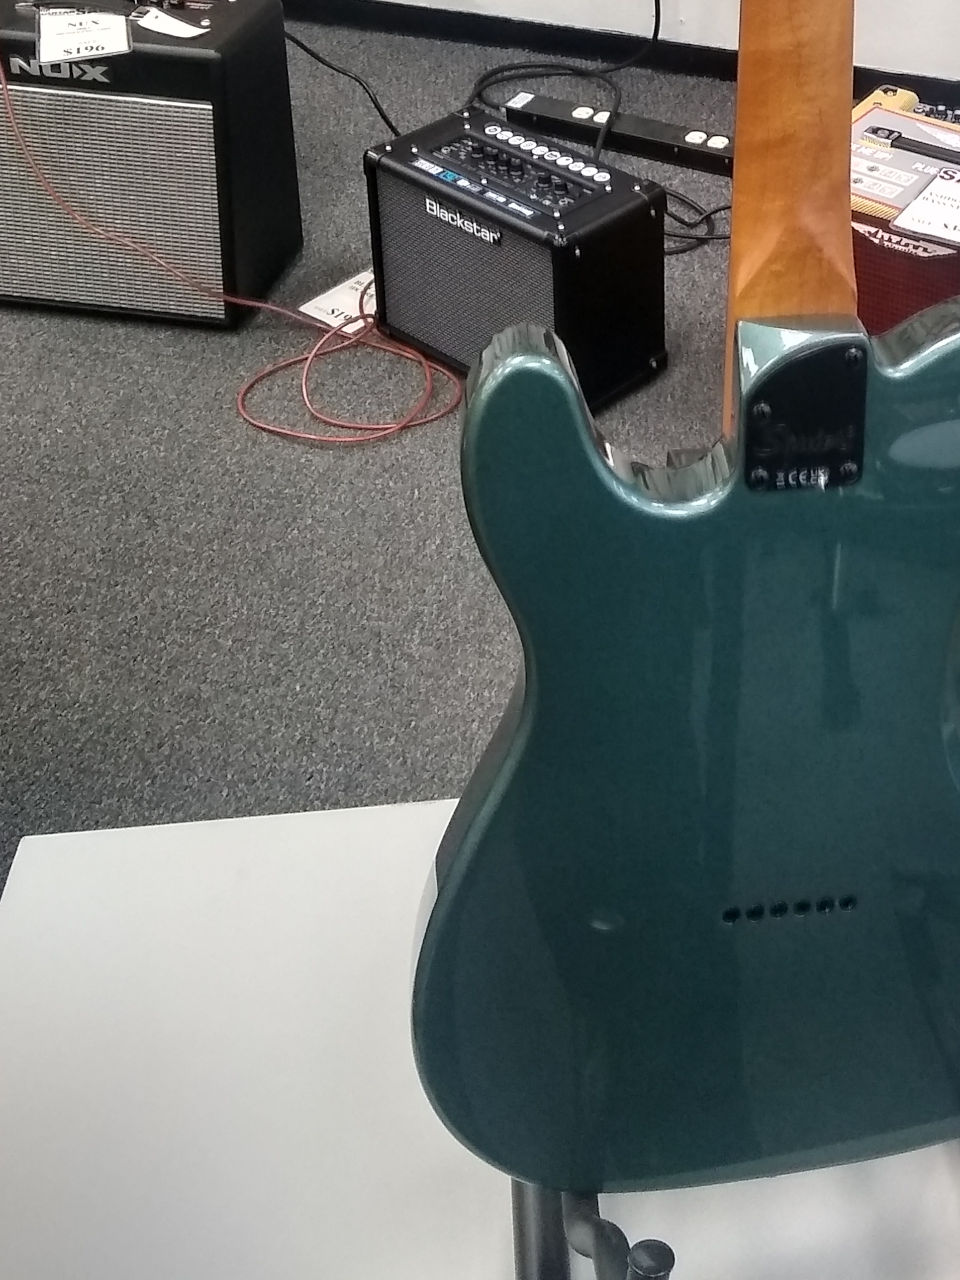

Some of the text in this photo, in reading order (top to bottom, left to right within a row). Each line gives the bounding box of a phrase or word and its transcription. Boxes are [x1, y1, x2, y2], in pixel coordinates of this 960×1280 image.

[63, 45, 105, 57] $196
[9, 55, 110, 83] NUX
[425, 197, 500, 244] Blackstar
